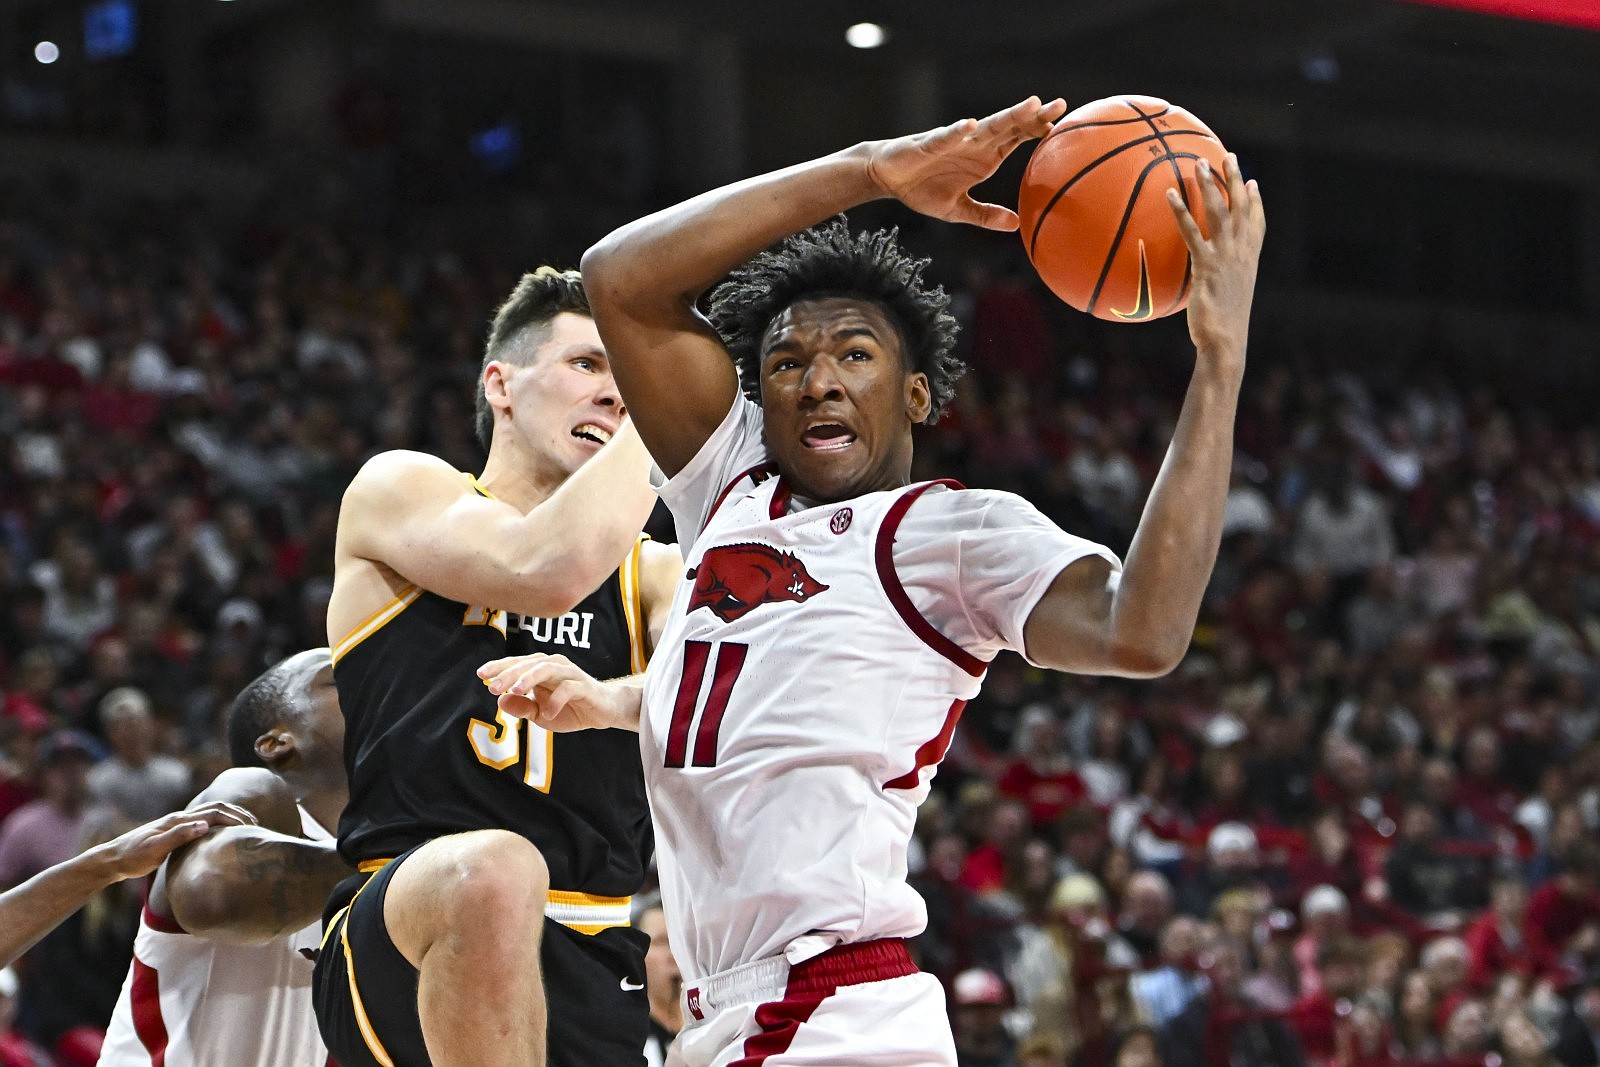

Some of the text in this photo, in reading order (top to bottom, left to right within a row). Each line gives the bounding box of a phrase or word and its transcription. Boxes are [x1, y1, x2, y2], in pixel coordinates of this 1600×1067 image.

[831, 509, 852, 533] SEC
[467, 679, 553, 794] 31
[664, 640, 749, 768] 11
